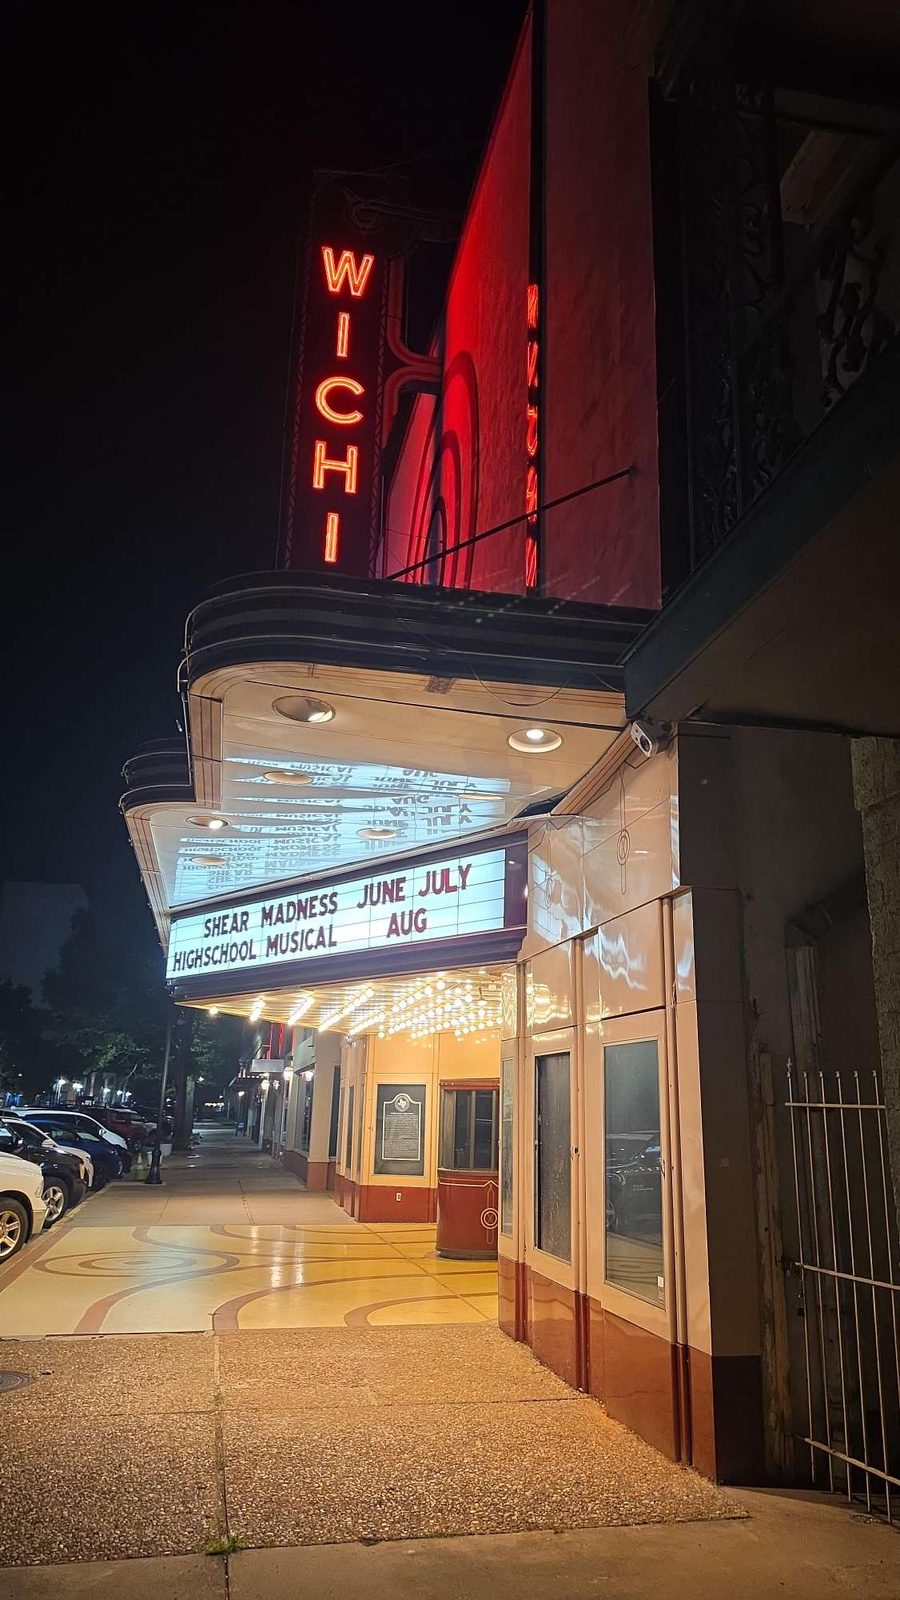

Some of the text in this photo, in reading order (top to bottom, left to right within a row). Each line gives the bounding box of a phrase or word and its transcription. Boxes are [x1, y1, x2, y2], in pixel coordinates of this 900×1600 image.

[313, 246, 375, 563] WICHI
[203, 863, 473, 939] SHEAR MADNESS JUNE JULY
[173, 908, 428, 973] HIGHSCHOOL MUSICAL AUG
